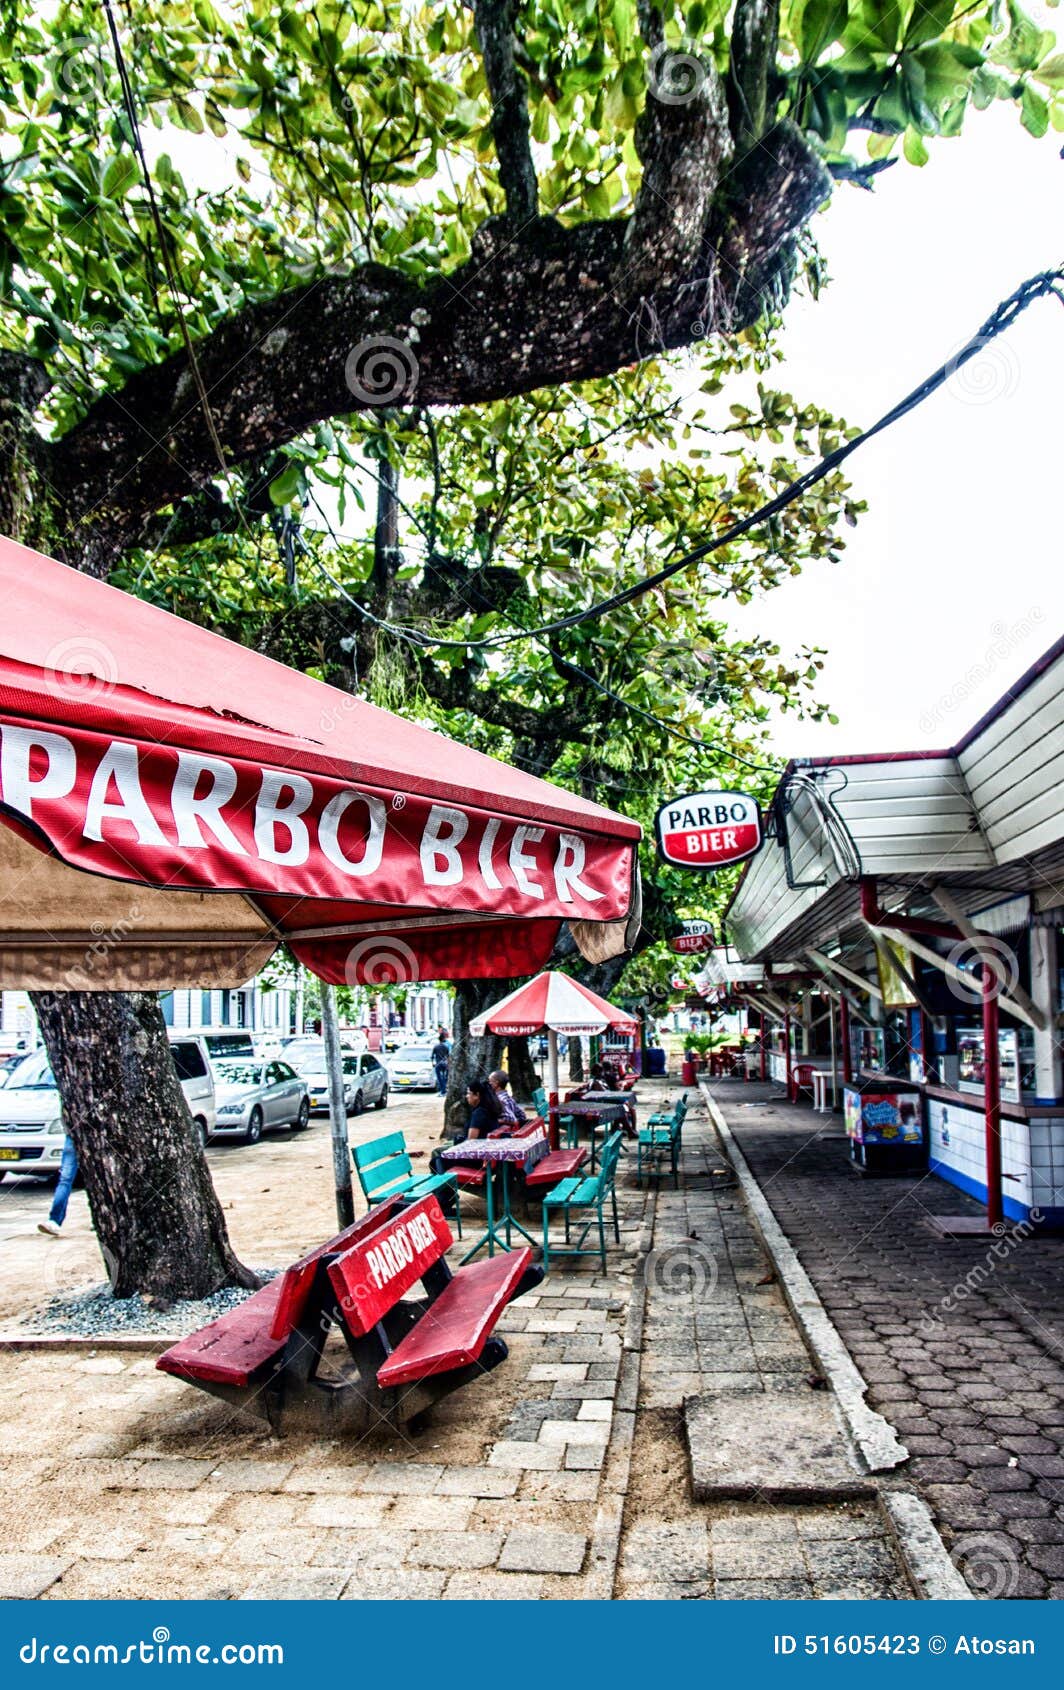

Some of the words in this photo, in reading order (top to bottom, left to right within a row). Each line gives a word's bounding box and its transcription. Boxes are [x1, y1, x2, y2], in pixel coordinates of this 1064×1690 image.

[668, 803, 747, 830] PARBO
[418, 804, 606, 903] BIER
[686, 830, 739, 854] BIER
[683, 924, 708, 936] RBO
[679, 937, 703, 949] BIER
[365, 1226, 414, 1290] PARBO
[406, 1212, 438, 1255] BIER
